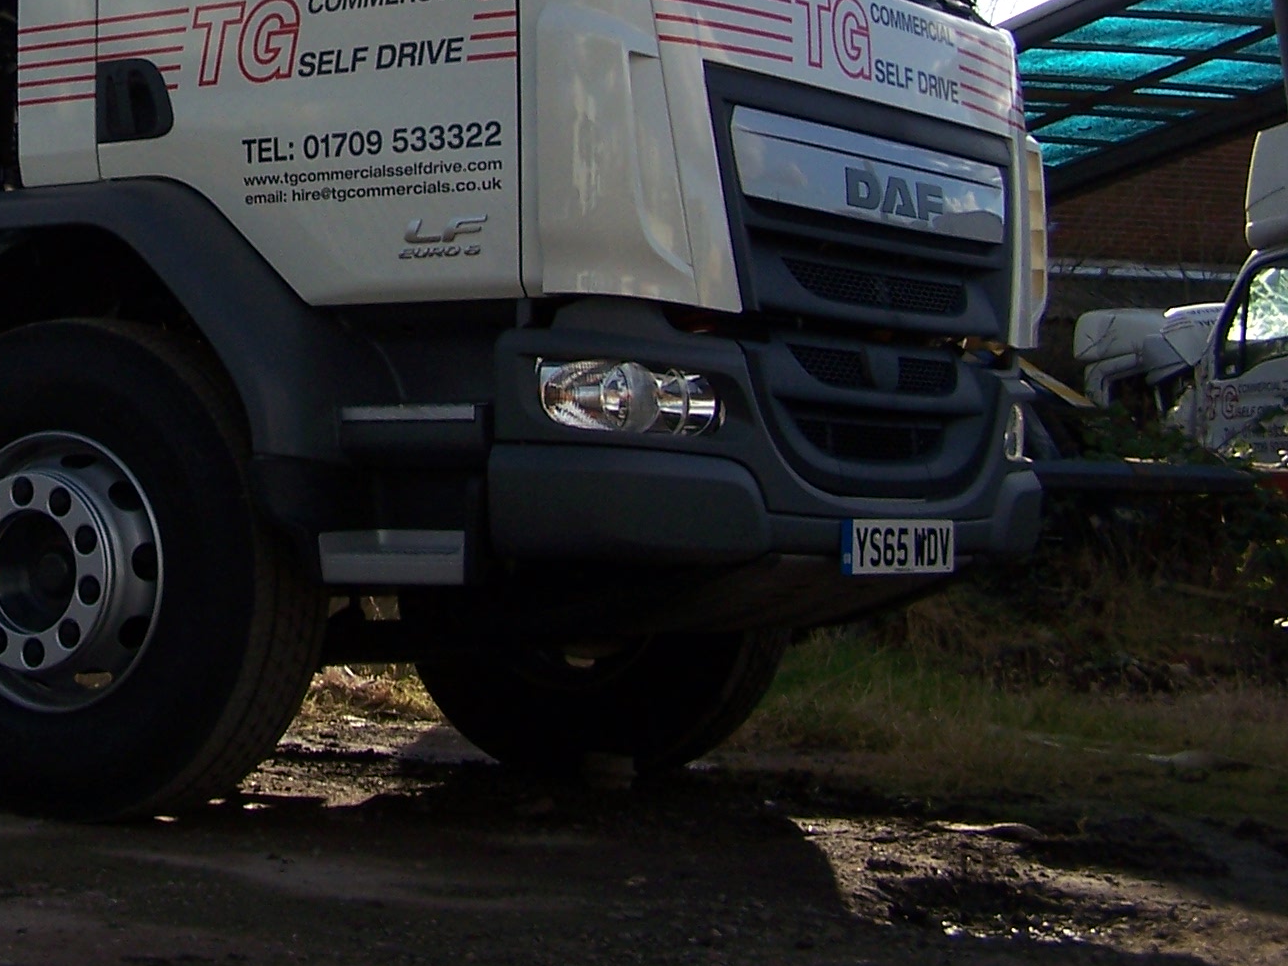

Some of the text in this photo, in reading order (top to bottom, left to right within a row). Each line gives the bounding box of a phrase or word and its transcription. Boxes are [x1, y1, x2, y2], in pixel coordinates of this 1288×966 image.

[869, 1, 955, 48] COMMERCIAL
[297, 37, 464, 78] SELF DRIVE
[874, 58, 960, 106] SELF DRIVE
[241, 120, 502, 164] TEL: 01709 533322
[243, 159, 503, 187] www.tgcommercialsselfdrive.com
[244, 176, 502, 206] email: hire@tgcommercials.co.uk
[844, 165, 944, 222] DAF
[404, 213, 488, 244] LF
[398, 245, 461, 260] EURO
[1206, 384, 1239, 421] TG
[855, 527, 910, 568] YS65
